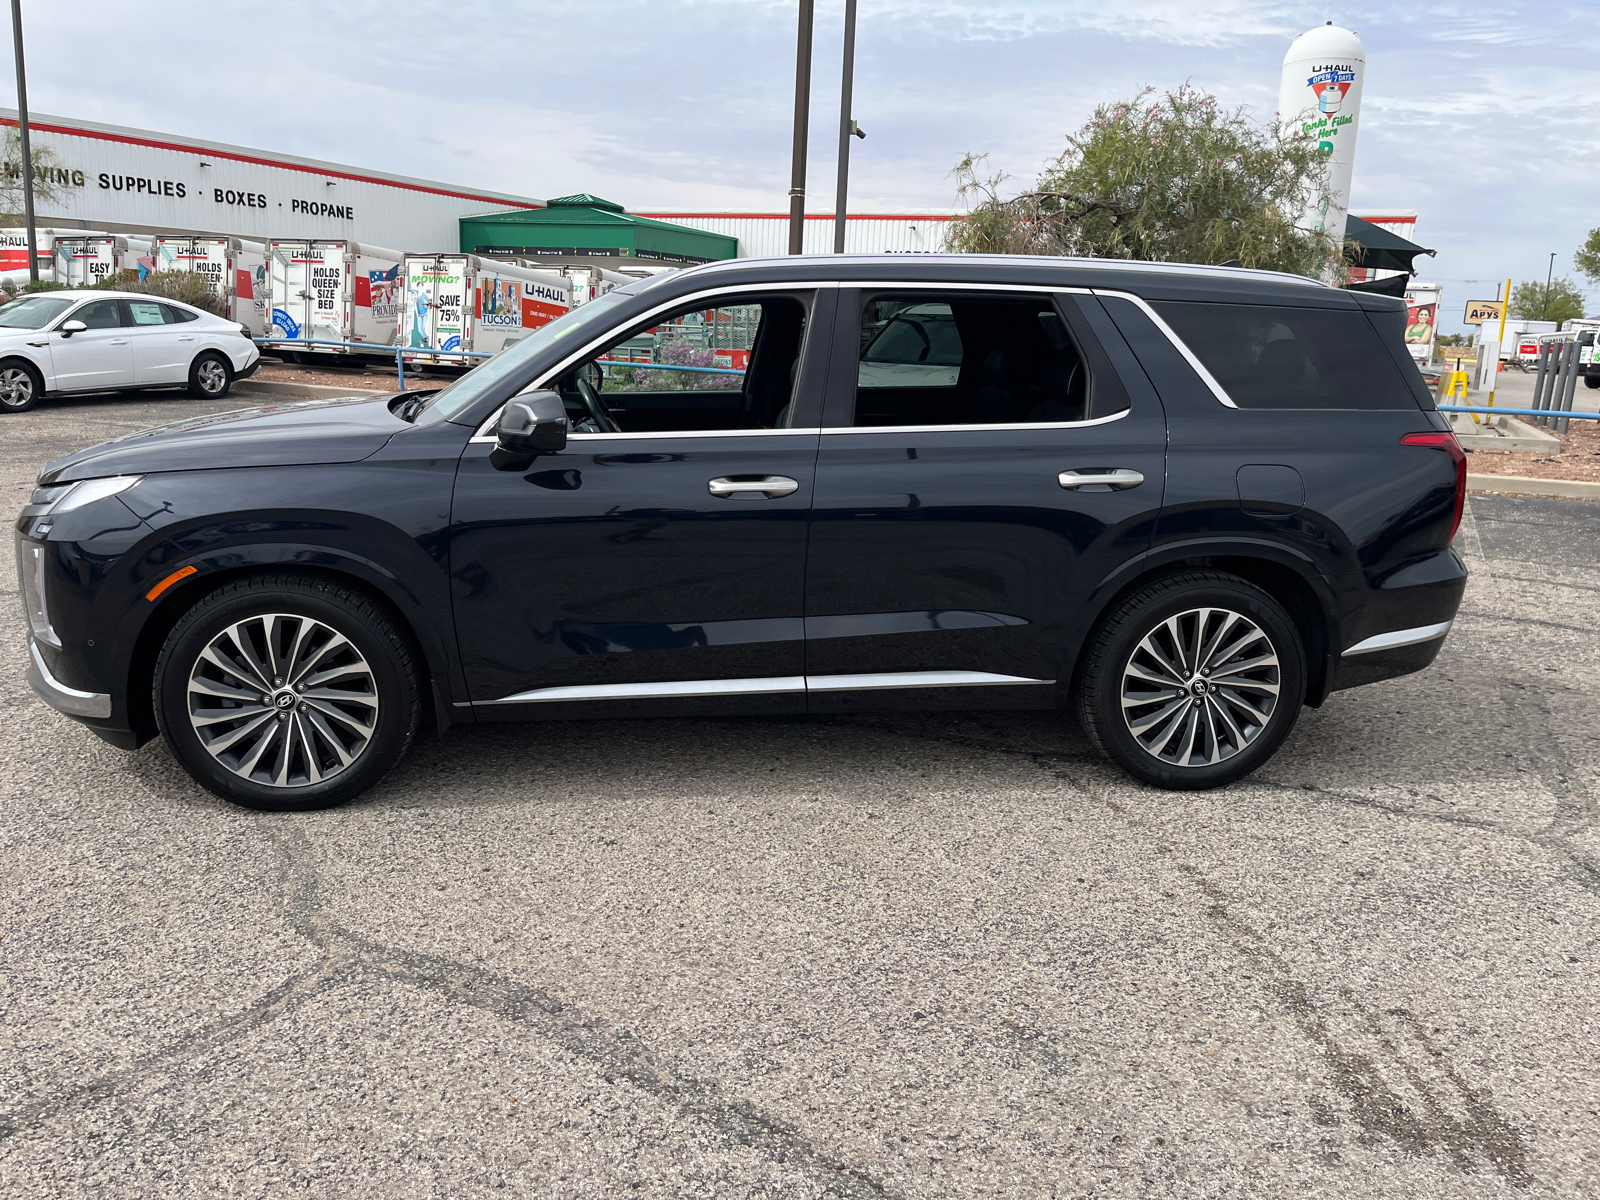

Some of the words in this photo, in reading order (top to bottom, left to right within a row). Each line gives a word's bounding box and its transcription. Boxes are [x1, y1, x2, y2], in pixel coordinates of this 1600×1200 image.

[1312, 73, 1331, 83] OPEN
[1301, 118, 1327, 132] Tanks
[1331, 114, 1353, 127] Filled
[1318, 128, 1338, 138] Here
[98, 173, 187, 198] SUPPLIES
[214, 188, 267, 209] BOXES
[291, 199, 354, 220] PROPANE
[72, 246, 98, 254] U-HAUL
[177, 246, 207, 255] U-HAUL
[291, 250, 324, 259] U-HAUL
[90, 262, 111, 273] EASY
[196, 262, 222, 273] HOLDS
[313, 268, 340, 278] HOLDS
[312, 278, 341, 289] QUEEN-
[411, 275, 460, 284] MOVING?
[317, 289, 335, 299] SIZE
[525, 283, 565, 303] U-HAUL
[318, 300, 334, 310] BED
[439, 295, 460, 307] SAVE
[439, 309, 460, 322] 75%
[482, 314, 517, 325] TUCSON
